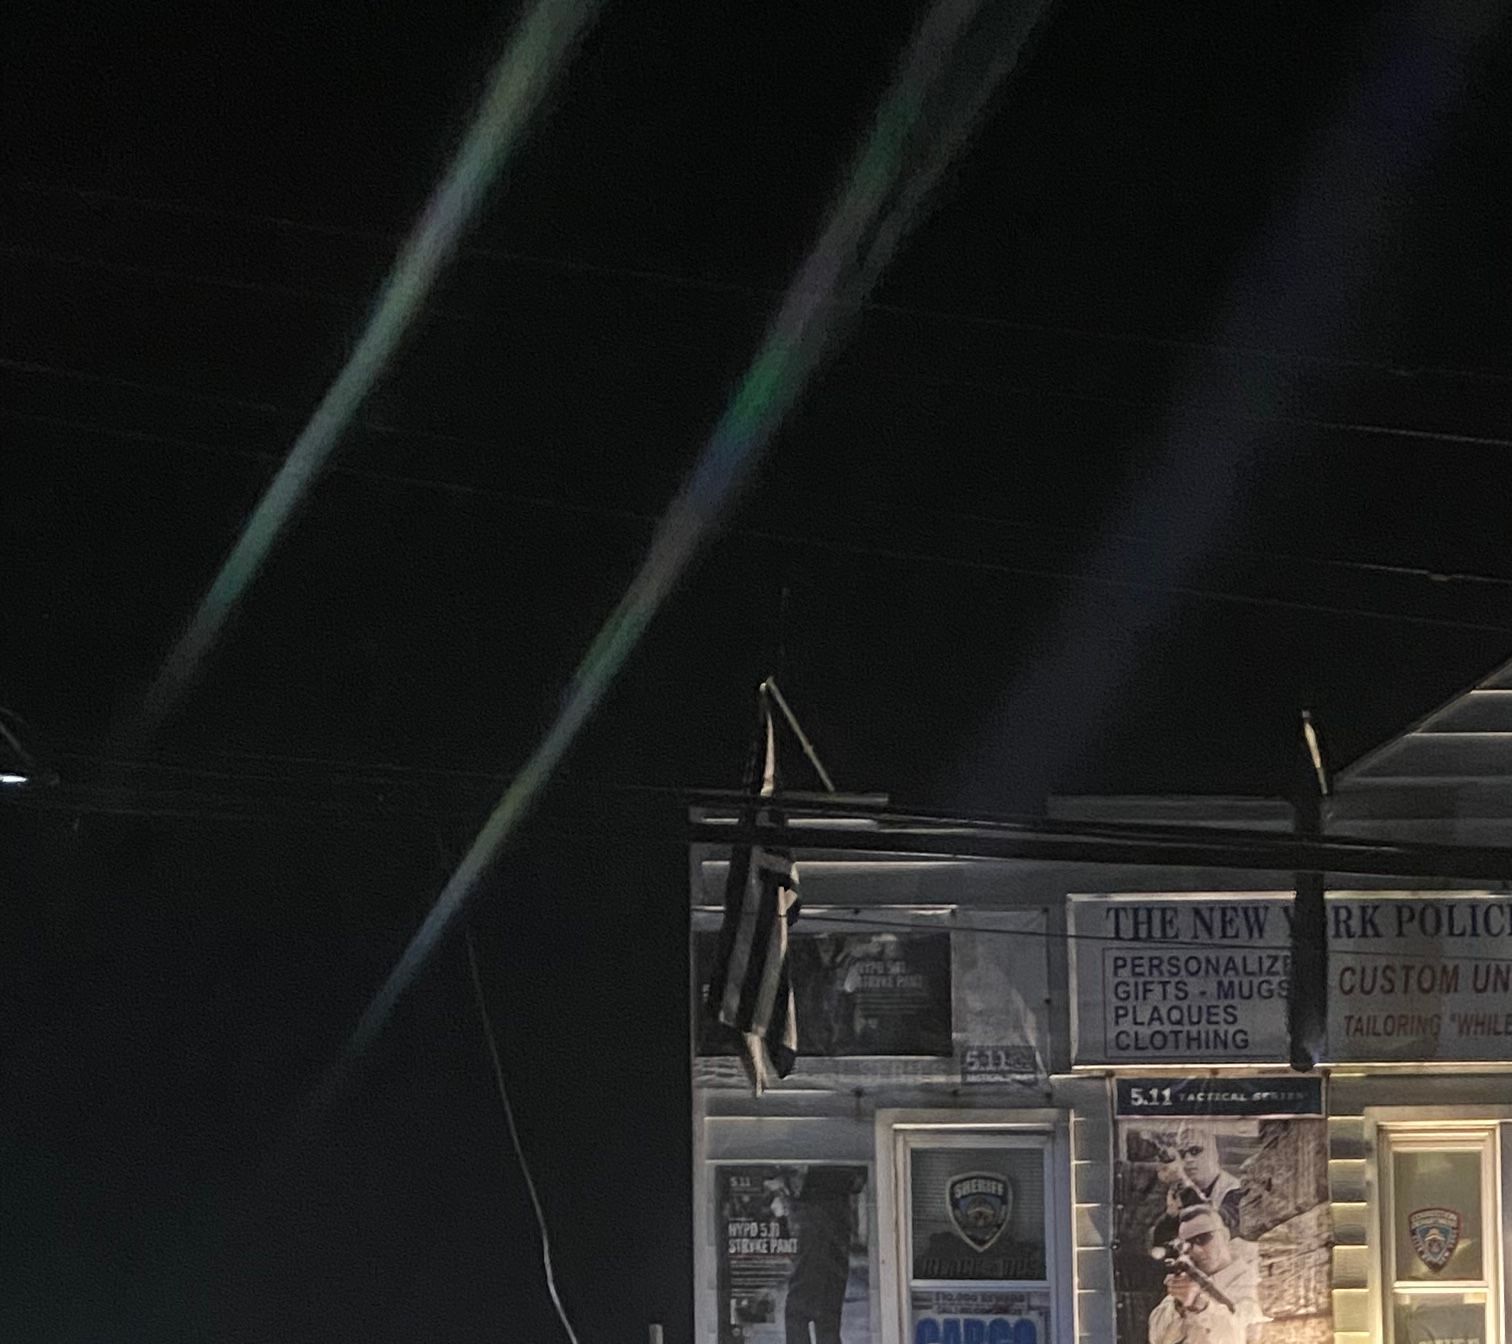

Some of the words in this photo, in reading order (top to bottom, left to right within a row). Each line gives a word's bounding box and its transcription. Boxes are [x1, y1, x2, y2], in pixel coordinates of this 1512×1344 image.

[1106, 905, 1180, 940] THE
[1190, 905, 1270, 940] NEW
[1114, 981, 1189, 1001] GIFTS
[1216, 979, 1291, 1000] MUGS
[1339, 964, 1459, 995] CUSTOM
[1113, 1005, 1239, 1025] PLAQUES
[1344, 1014, 1440, 1036] TAILORING
[1114, 1030, 1250, 1050] CLOTHING
[1130, 1088, 1173, 1106] 5.11
[953, 1180, 1005, 1199] SHERIFF
